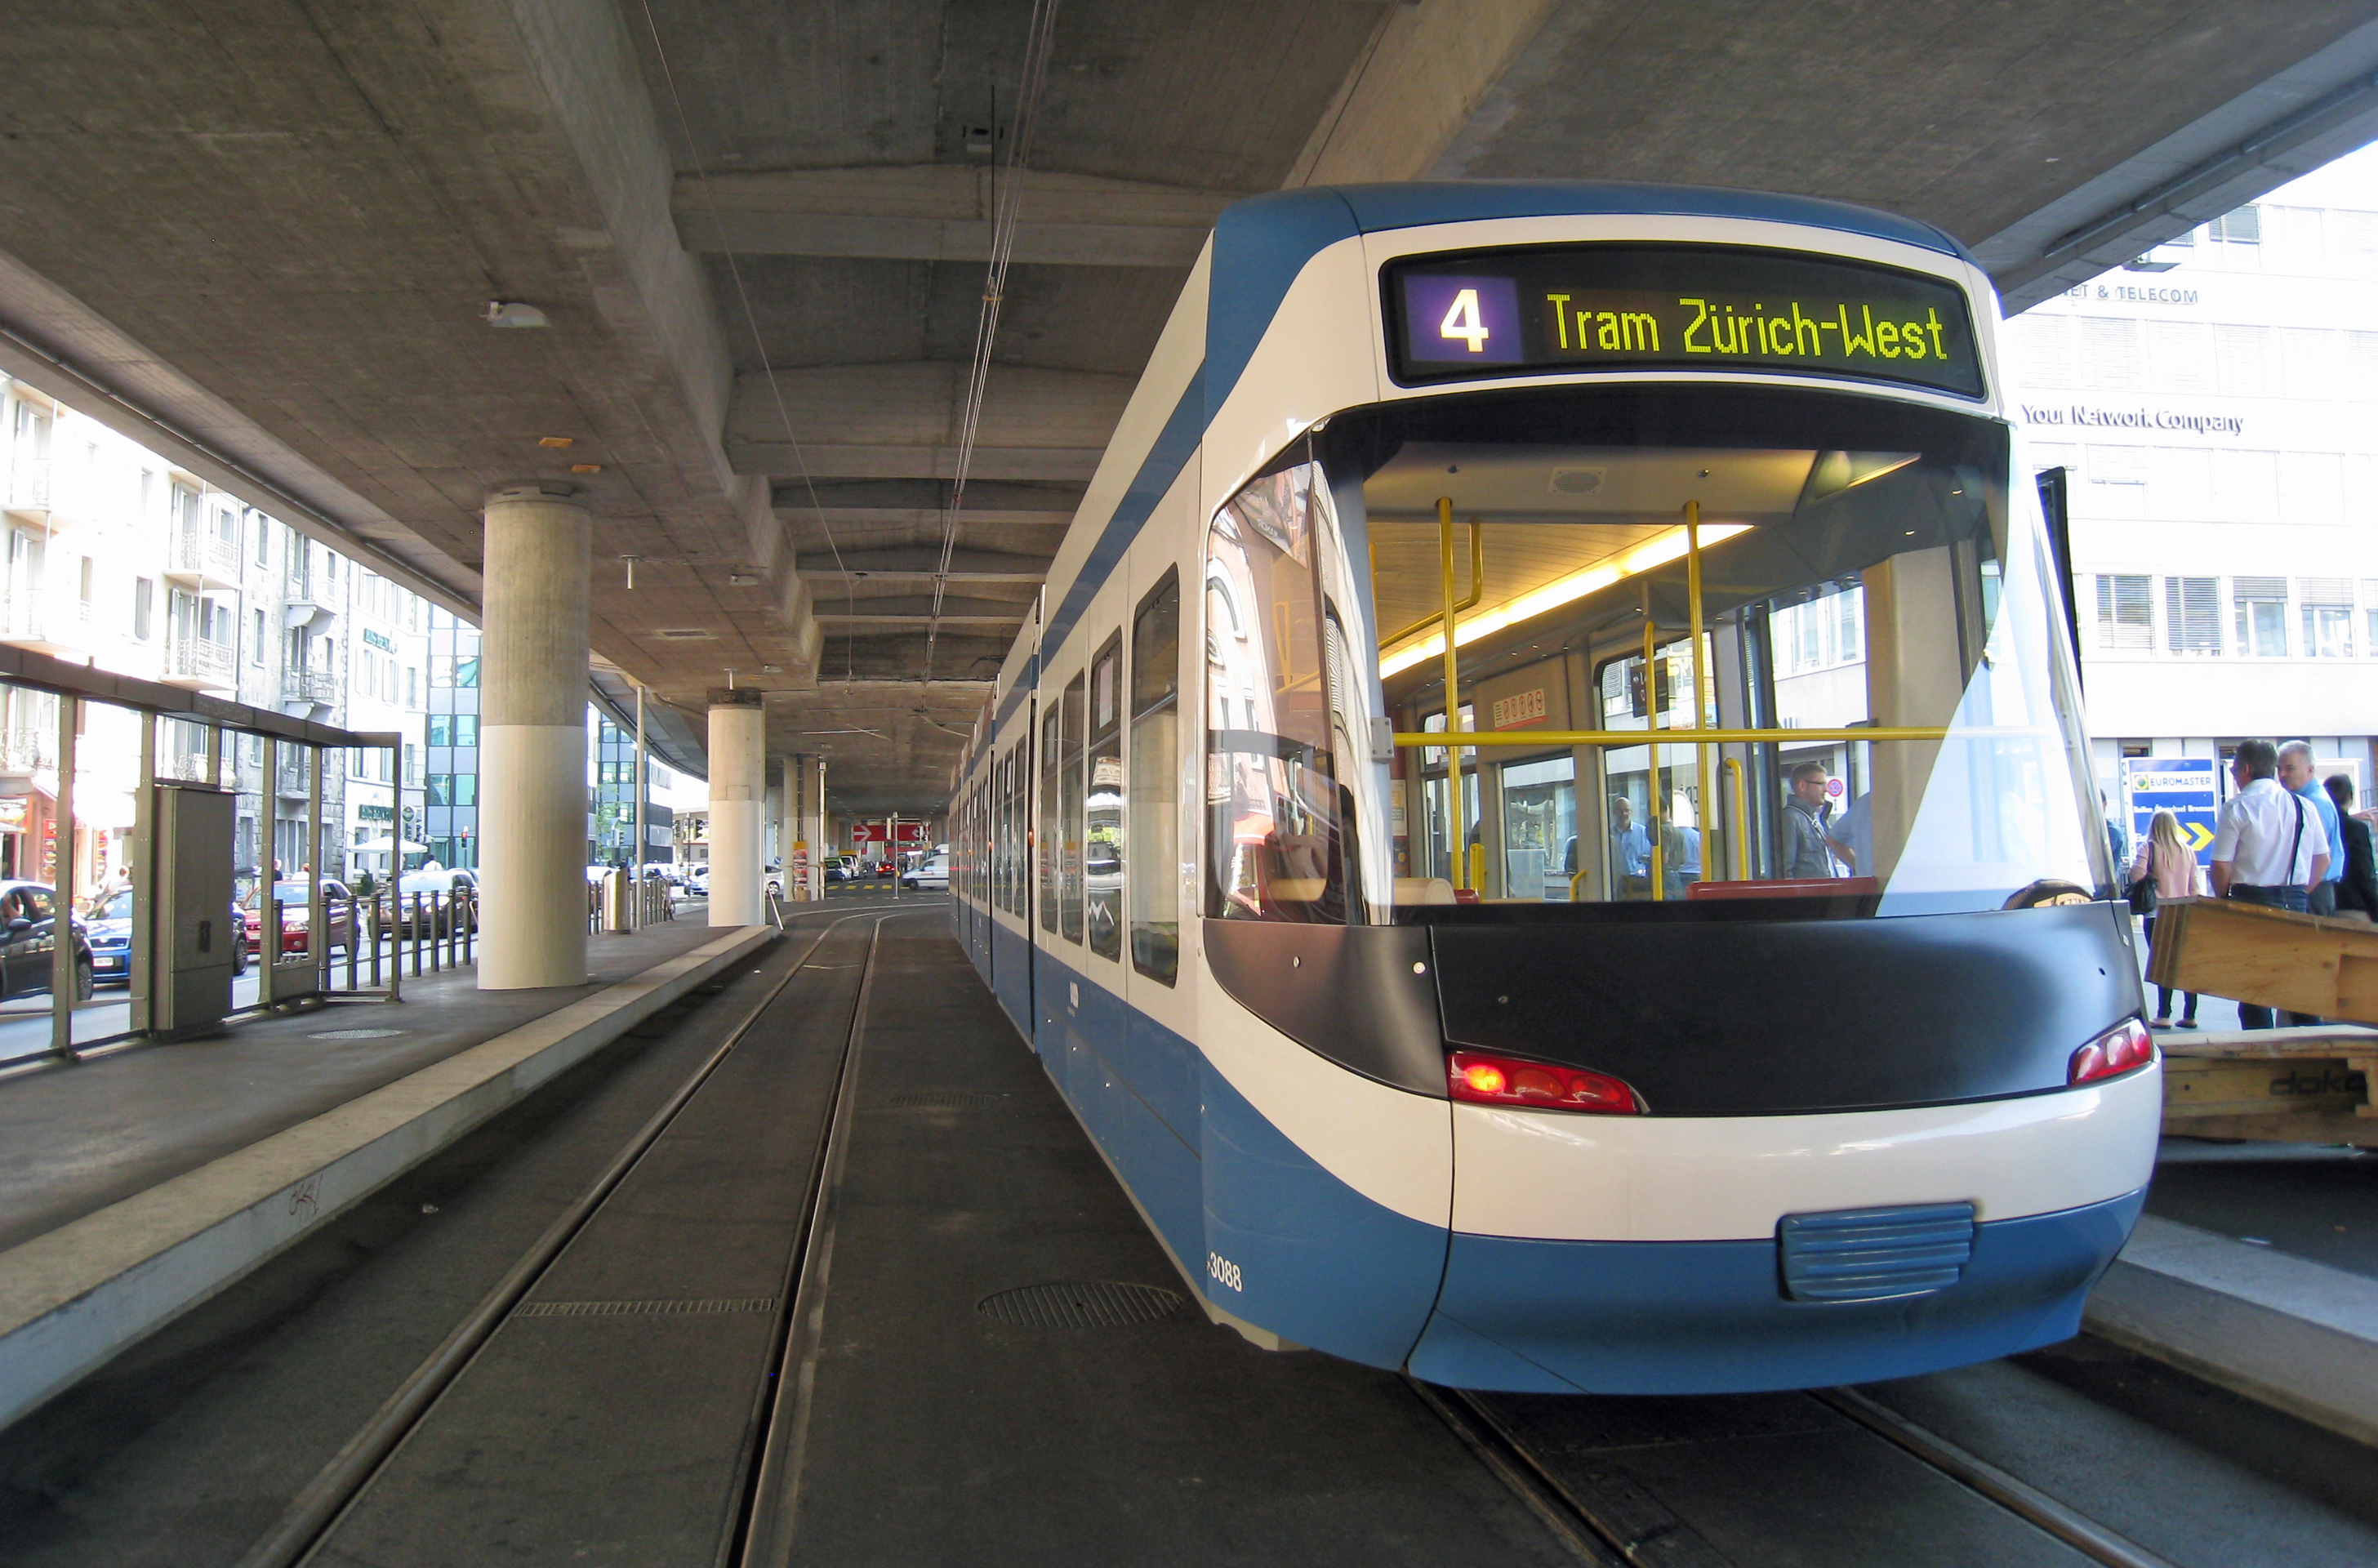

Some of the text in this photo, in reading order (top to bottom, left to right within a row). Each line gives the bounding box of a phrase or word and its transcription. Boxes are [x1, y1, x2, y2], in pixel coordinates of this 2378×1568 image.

[2098, 285, 2109, 299] &
[2118, 286, 2198, 304] TELECOM
[1439, 289, 1948, 360] 4 Tram Zürich-West
[2021, 404, 2243, 436] Your Network Company
[2150, 777, 2211, 786] EUROMASTER
[1209, 1250, 1243, 1293] 3088
